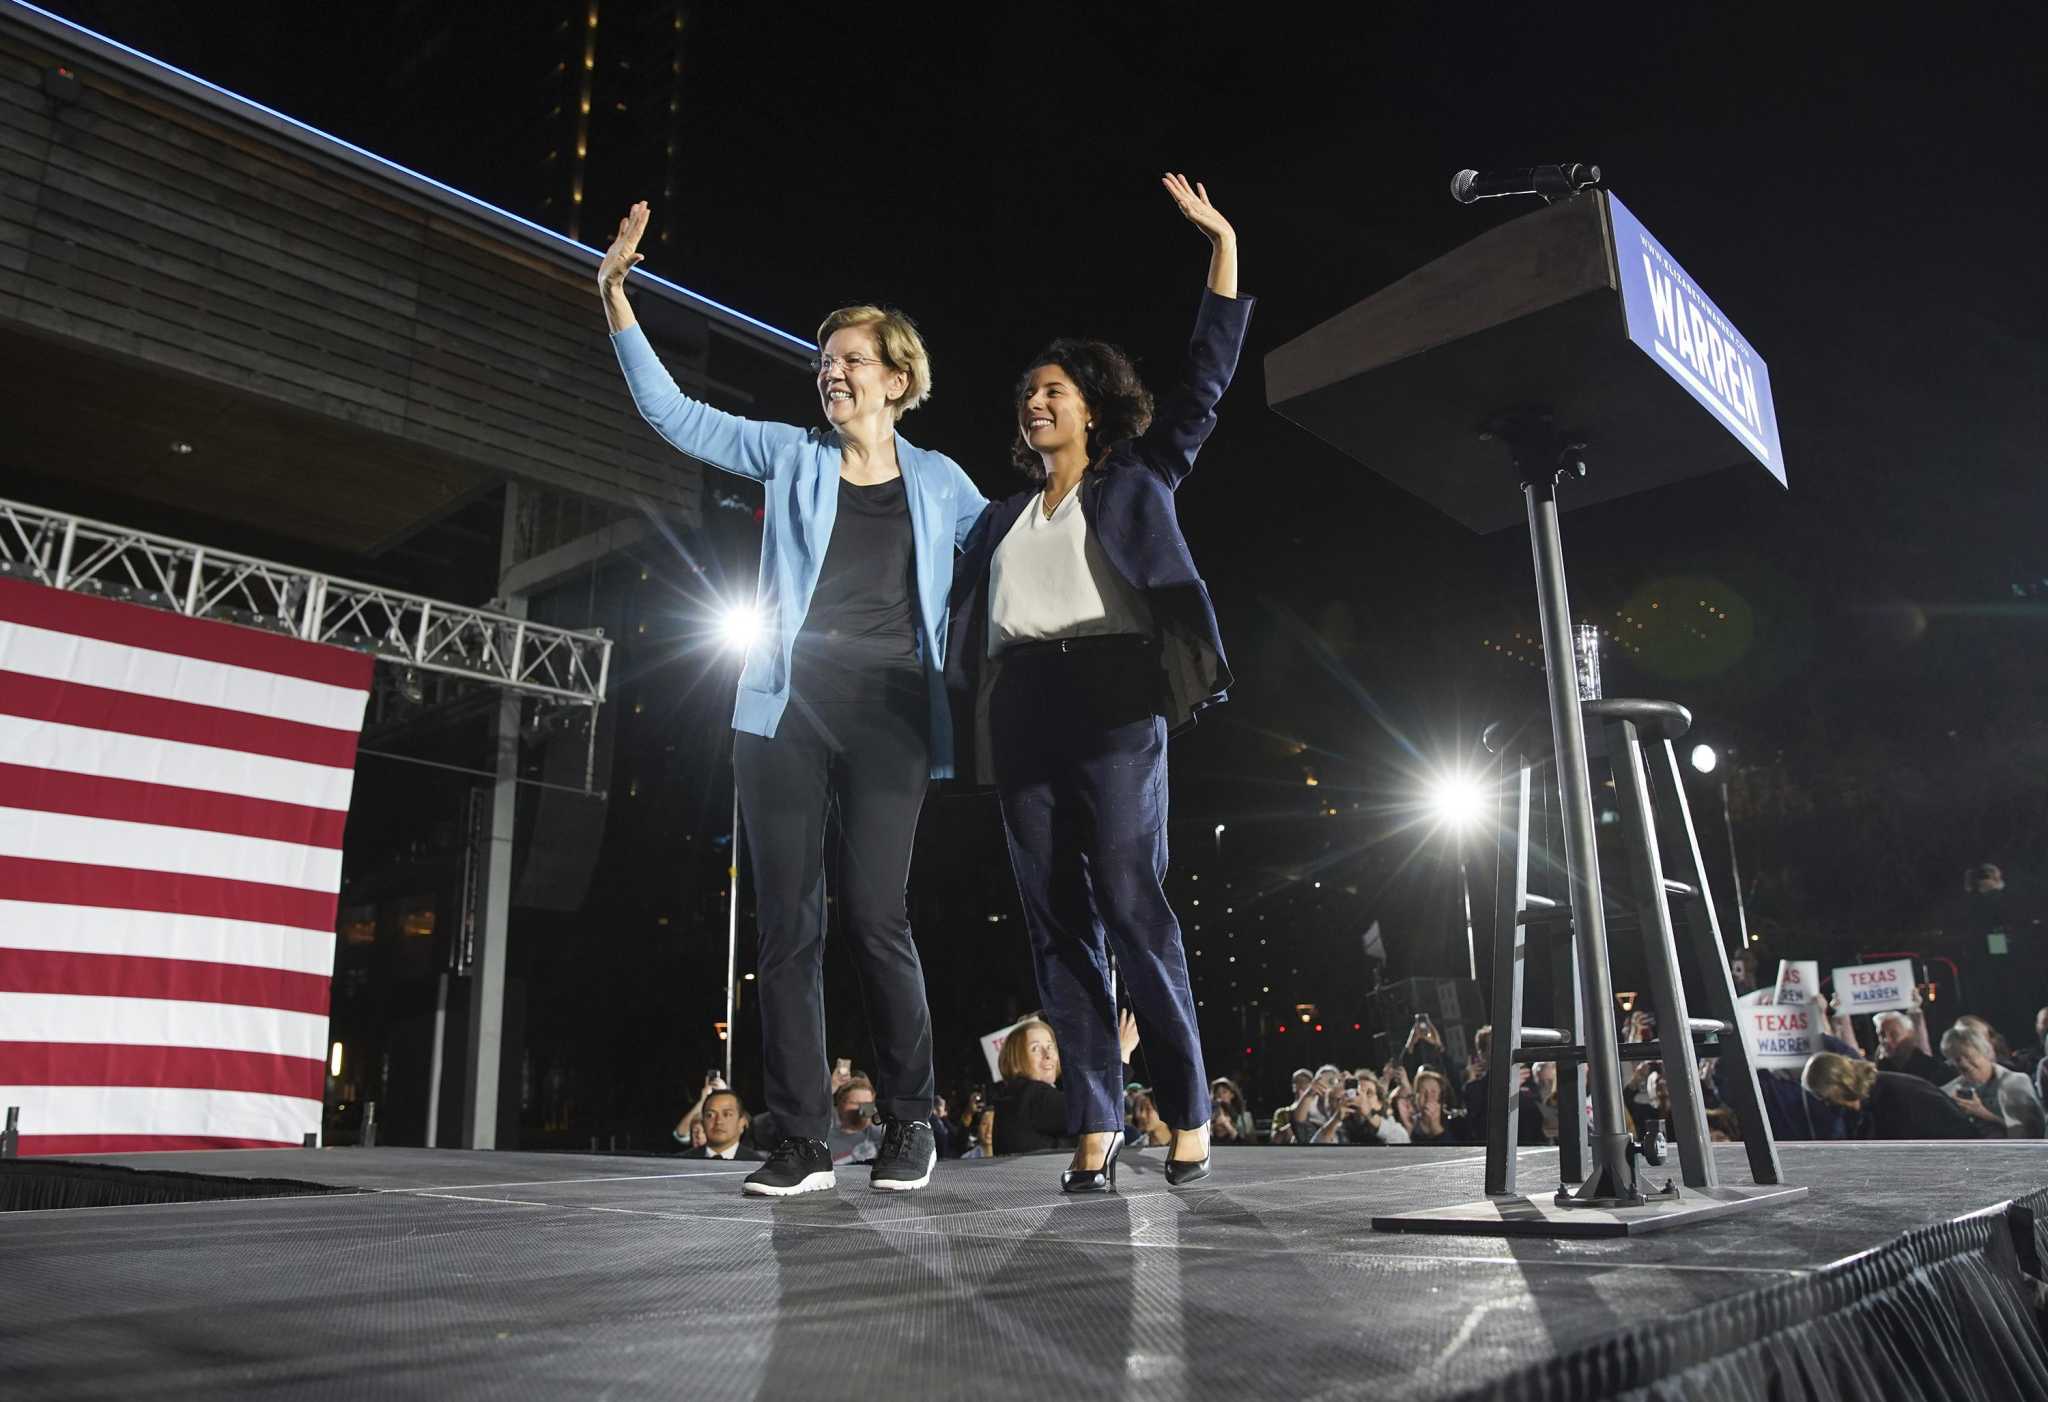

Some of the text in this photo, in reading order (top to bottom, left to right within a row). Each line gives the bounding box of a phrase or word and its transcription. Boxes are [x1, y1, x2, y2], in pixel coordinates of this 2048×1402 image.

[1643, 253, 1762, 436] WARREN
[1849, 969, 1897, 985] TEXAS
[1853, 987, 1899, 1001] WARREN
[1754, 1012, 1809, 1031] TEXAS
[1757, 1037, 1810, 1053] WARREN
